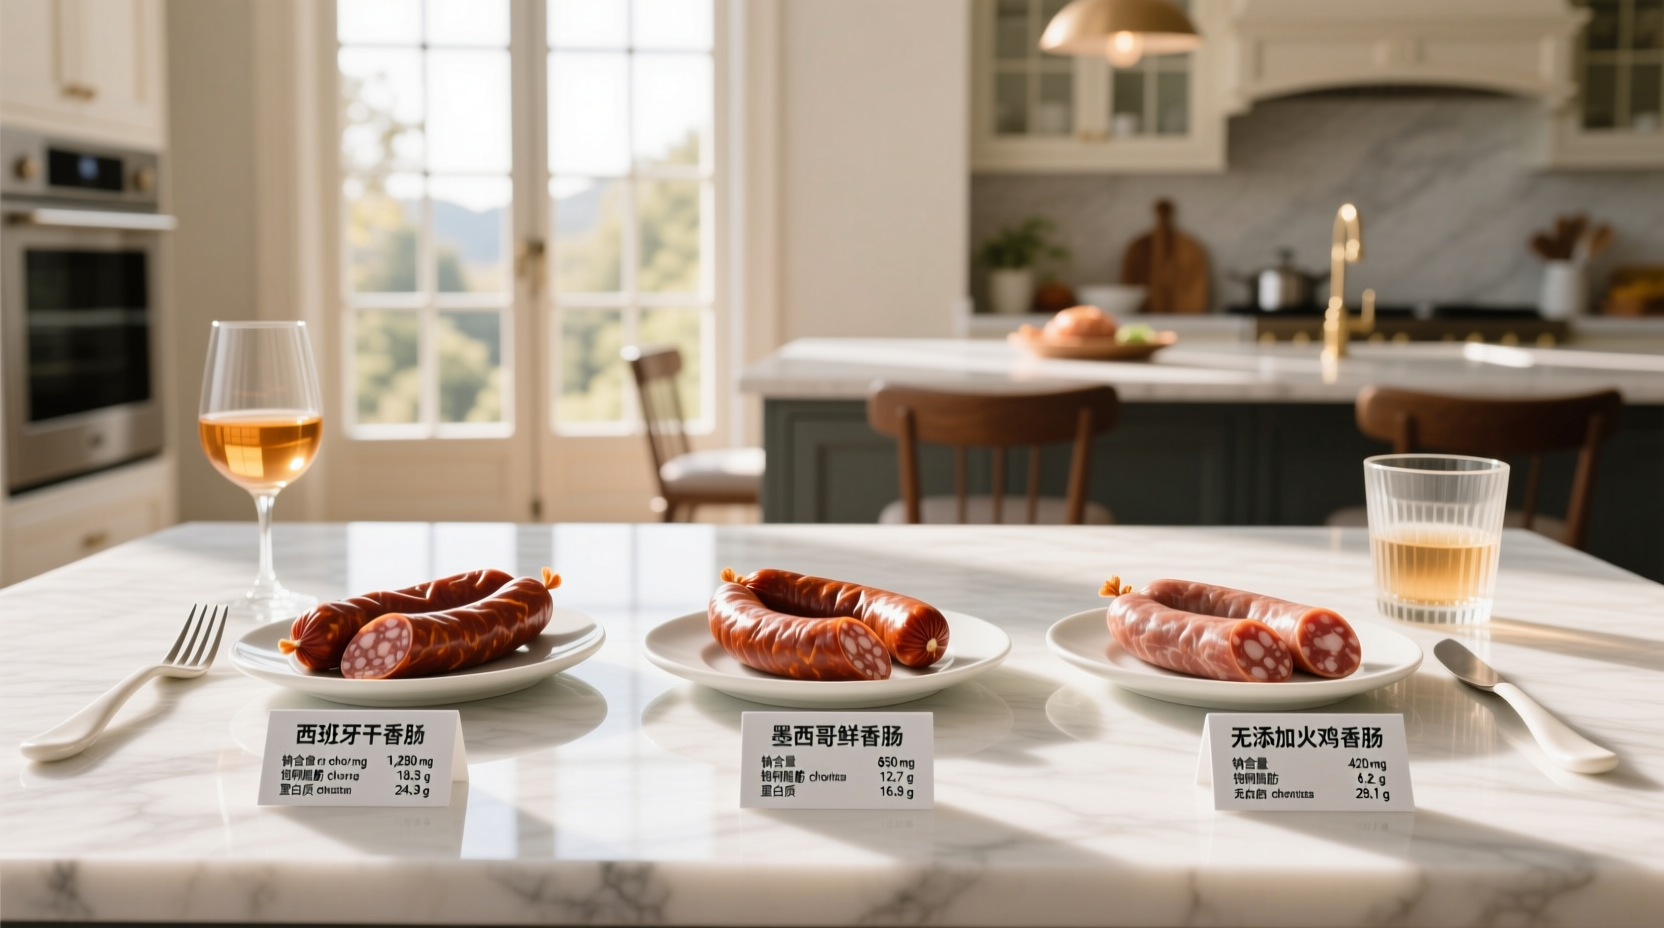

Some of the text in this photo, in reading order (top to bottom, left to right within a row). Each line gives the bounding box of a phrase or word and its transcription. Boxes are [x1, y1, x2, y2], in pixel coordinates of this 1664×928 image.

[296, 723, 425, 745] 西班牙干香肠
[772, 724, 903, 747] 墨西哥鲜香肠
[1231, 725, 1383, 748] 无添加火鸡香肠
[419, 758, 433, 769] mg
[900, 759, 915, 770] mg
[424, 773, 431, 783] g
[880, 771, 914, 784] 12.7 g
[1379, 776, 1386, 786] g
[422, 788, 430, 798] g
[880, 786, 914, 799] 16.9 g
[1383, 791, 1390, 802] g
